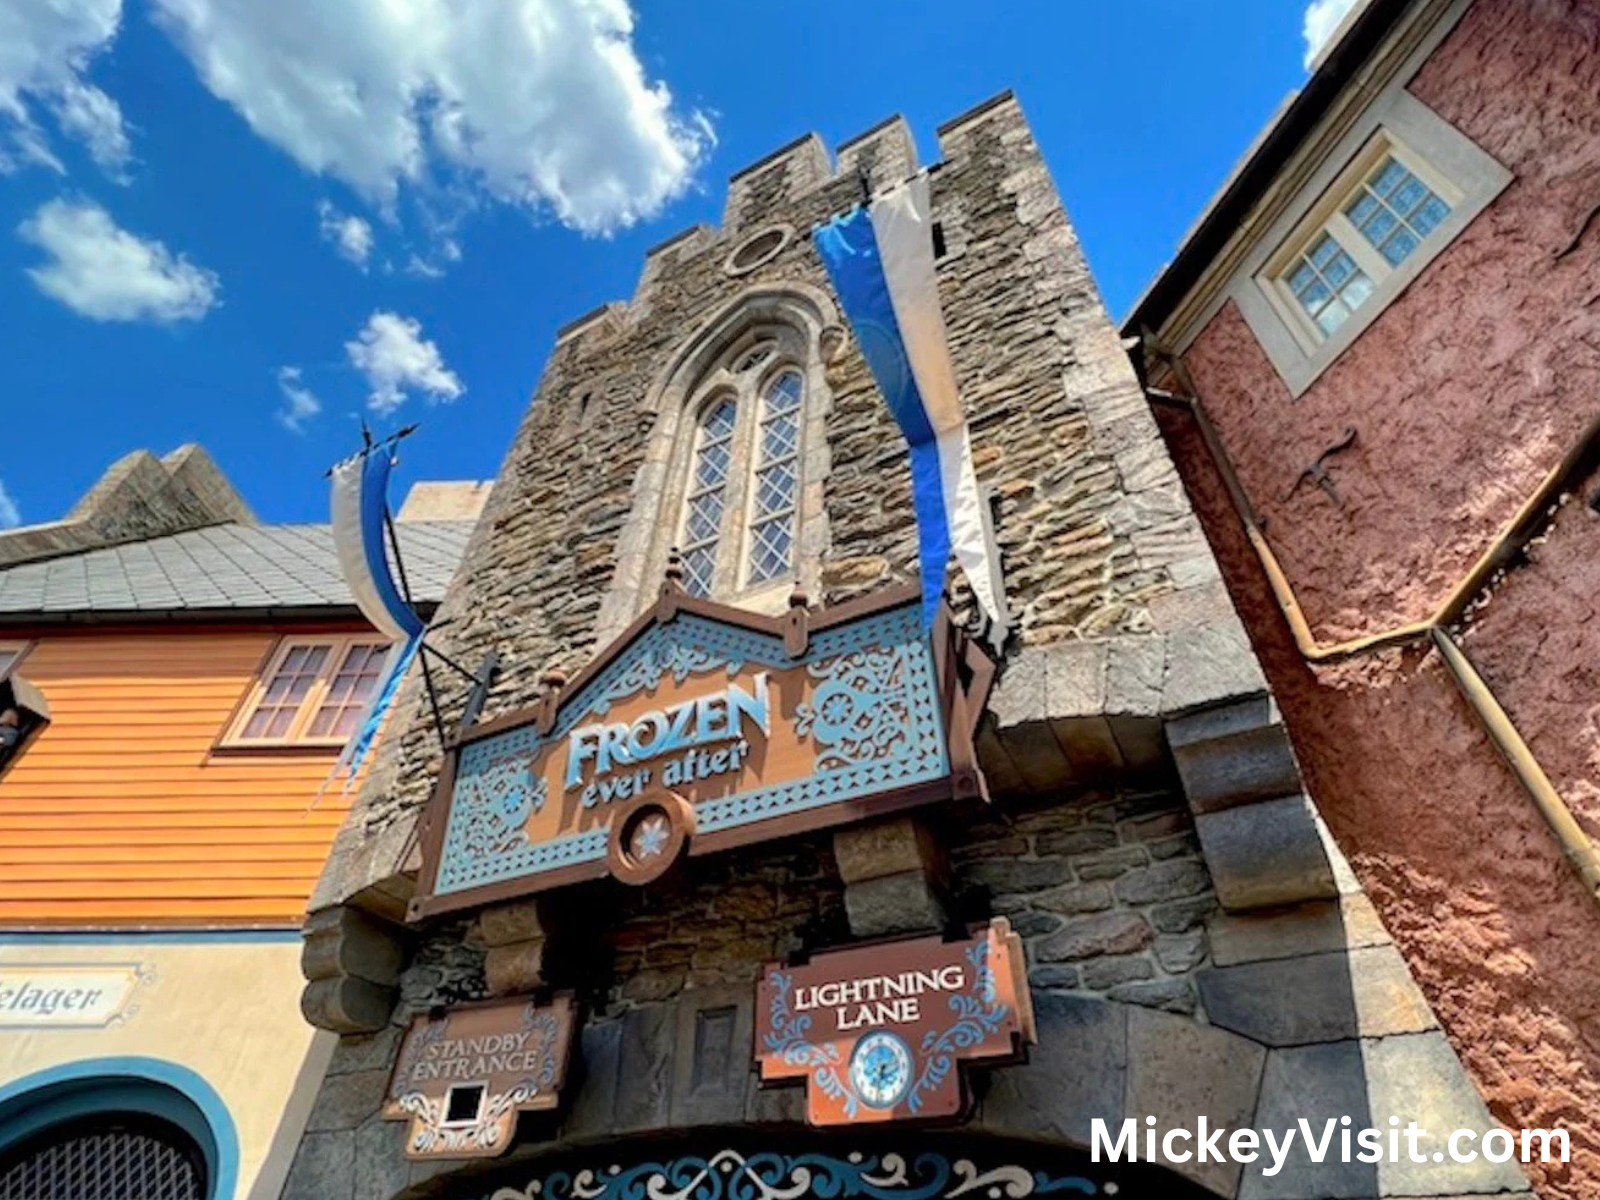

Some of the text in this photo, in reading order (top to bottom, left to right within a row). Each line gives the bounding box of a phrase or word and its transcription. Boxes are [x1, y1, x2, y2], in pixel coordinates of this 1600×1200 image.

[566, 671, 771, 789] FROZEN
[581, 740, 749, 809] ever after
[0, 980, 103, 1015] elager
[794, 966, 965, 1011] LIGHTNING
[836, 998, 920, 1030] LANE
[427, 1031, 532, 1059] STANDBY
[412, 1051, 538, 1082] ENTRANCE
